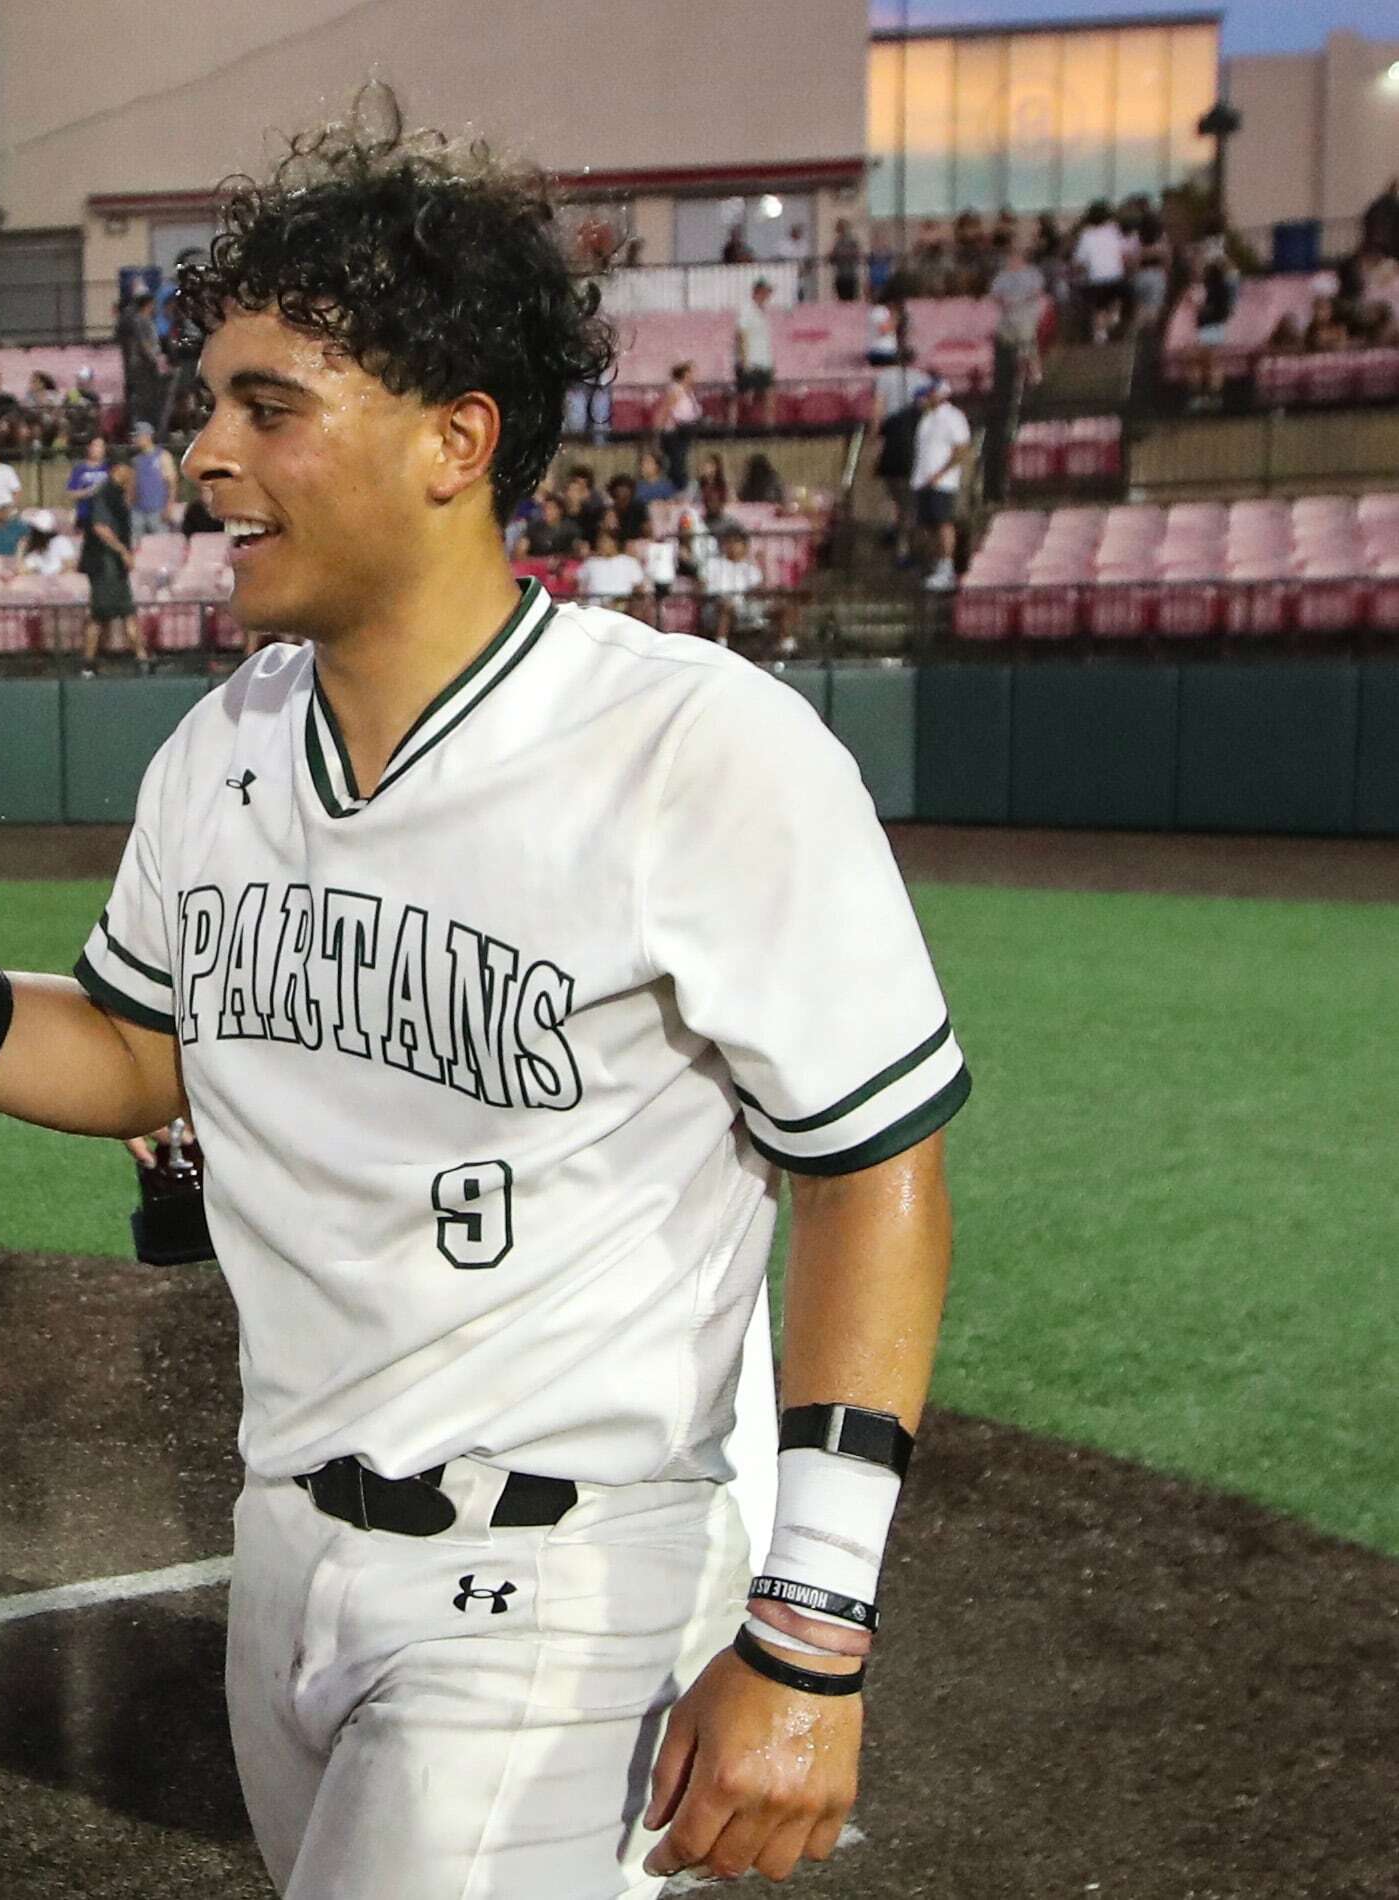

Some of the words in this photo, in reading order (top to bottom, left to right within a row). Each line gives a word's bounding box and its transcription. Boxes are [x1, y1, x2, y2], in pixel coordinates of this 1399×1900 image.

[177, 882, 583, 1112] PARTANS
[431, 1159, 514, 1270] 9
[773, 1581, 828, 1608] HUMBLE
